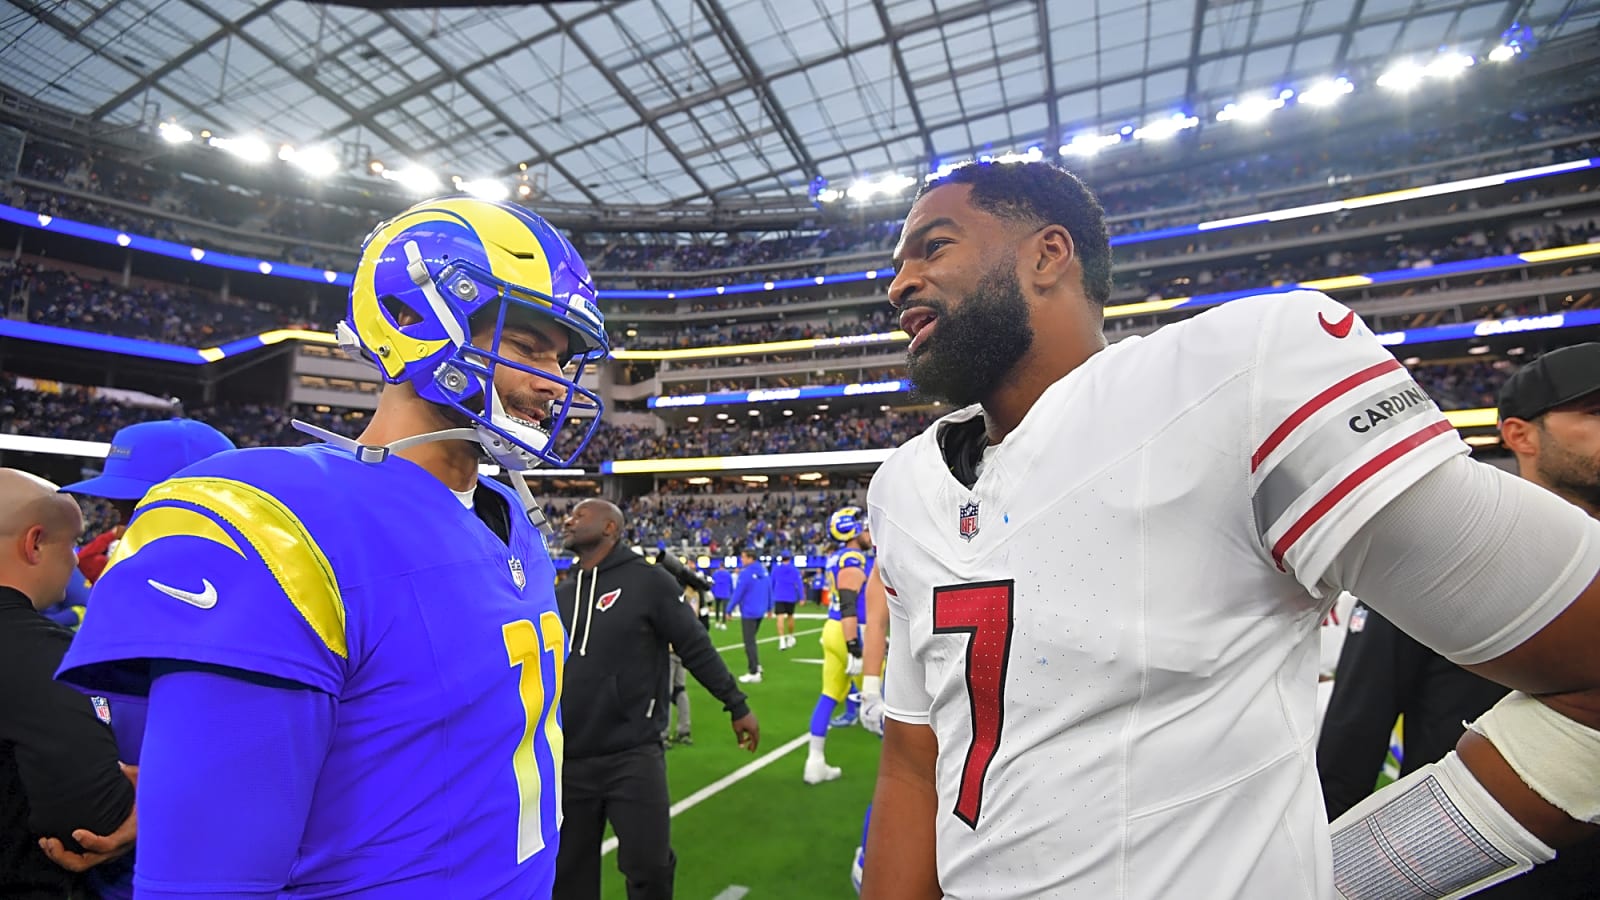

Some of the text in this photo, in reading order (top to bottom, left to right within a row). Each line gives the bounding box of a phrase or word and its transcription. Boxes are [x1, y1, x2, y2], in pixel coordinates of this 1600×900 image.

[961, 517, 977, 534] NFL
[502, 610, 565, 865] 11
[933, 579, 1014, 831] 7
